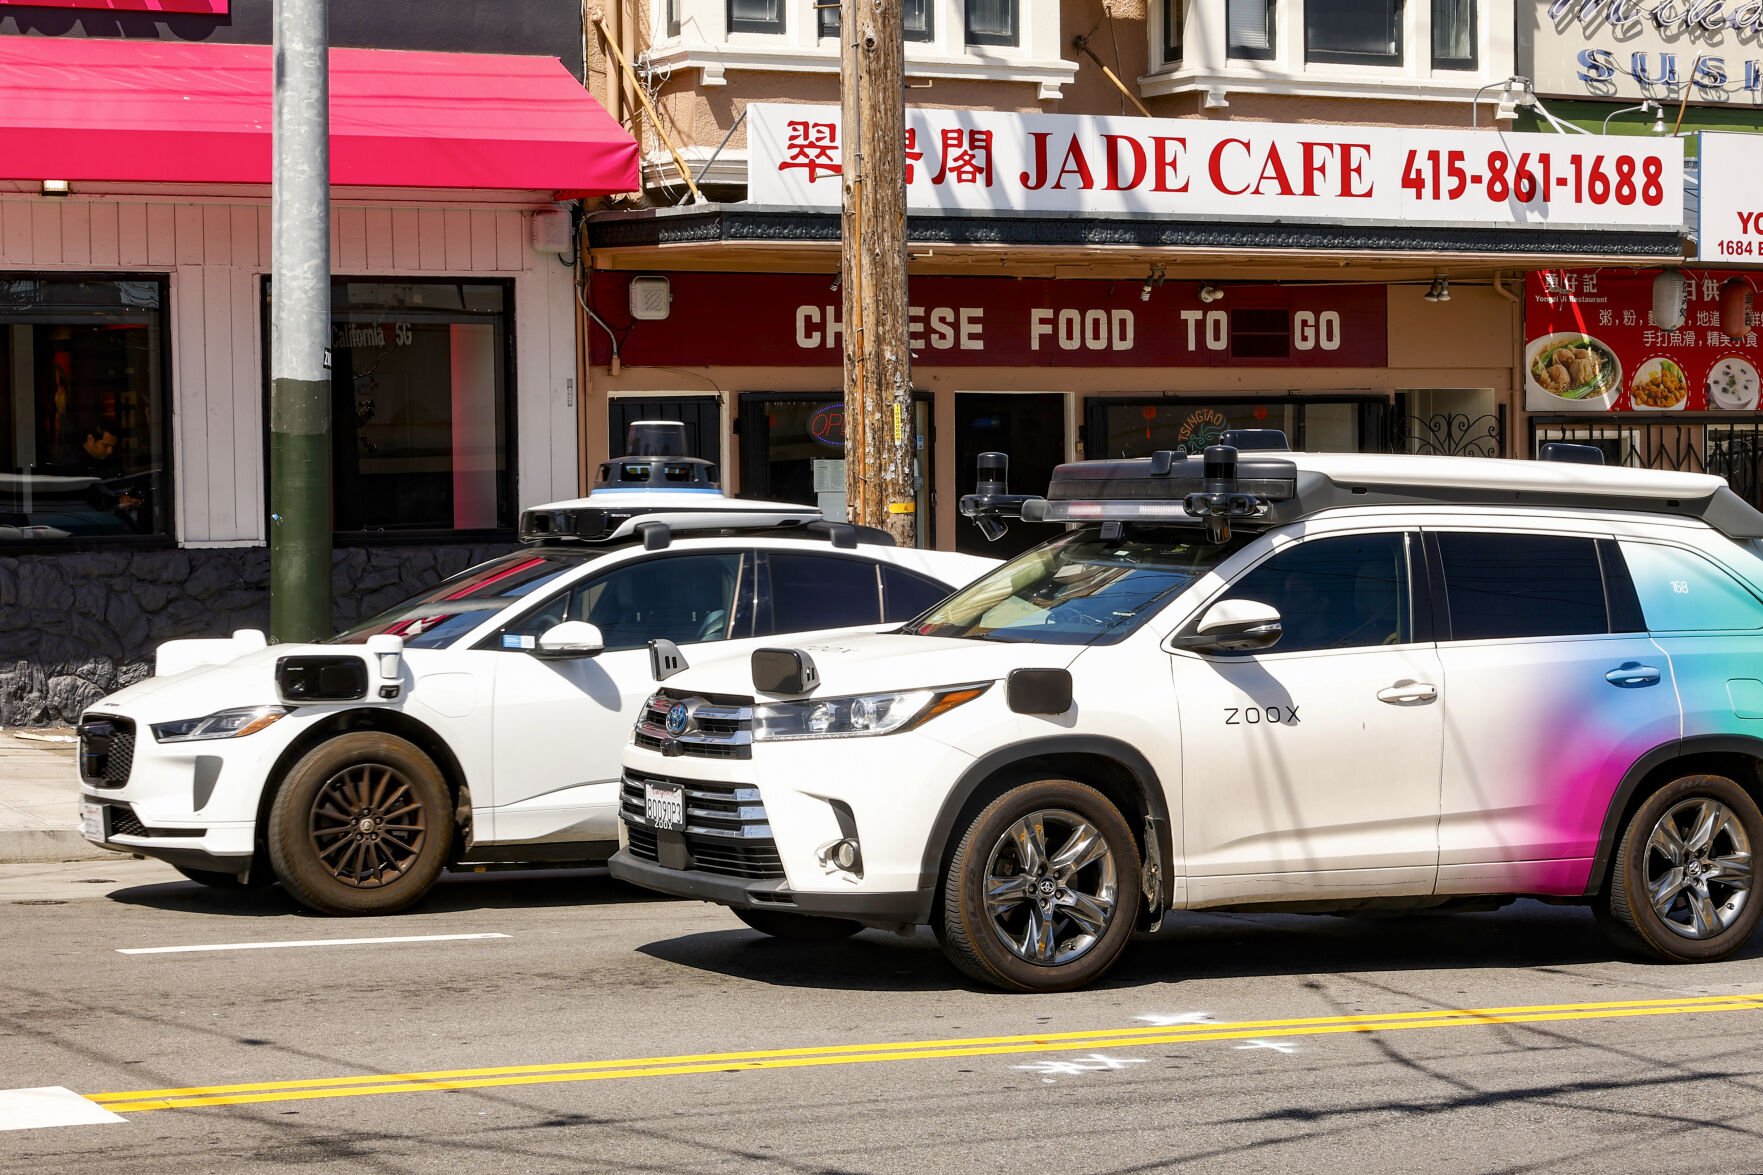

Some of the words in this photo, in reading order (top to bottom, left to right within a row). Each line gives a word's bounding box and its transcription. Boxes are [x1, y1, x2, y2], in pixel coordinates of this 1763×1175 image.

[778, 120, 993, 187] 翠閣
[1019, 132, 1190, 193] JADE
[1208, 138, 1374, 198] CAFE
[1401, 150, 1664, 207] 415-861-1688
[1718, 240, 1753, 255] 1684
[1569, 295, 1608, 304] Restaurant
[395, 322, 412, 347] 5G
[796, 305, 984, 350] CHESE
[1031, 308, 1134, 351] FOOD
[1180, 310, 1228, 351] TO
[1294, 310, 1340, 351] GO
[1670, 581, 1688, 593] 168
[1224, 706, 1301, 725] ZOOX
[654, 819, 673, 830] ZOOX
